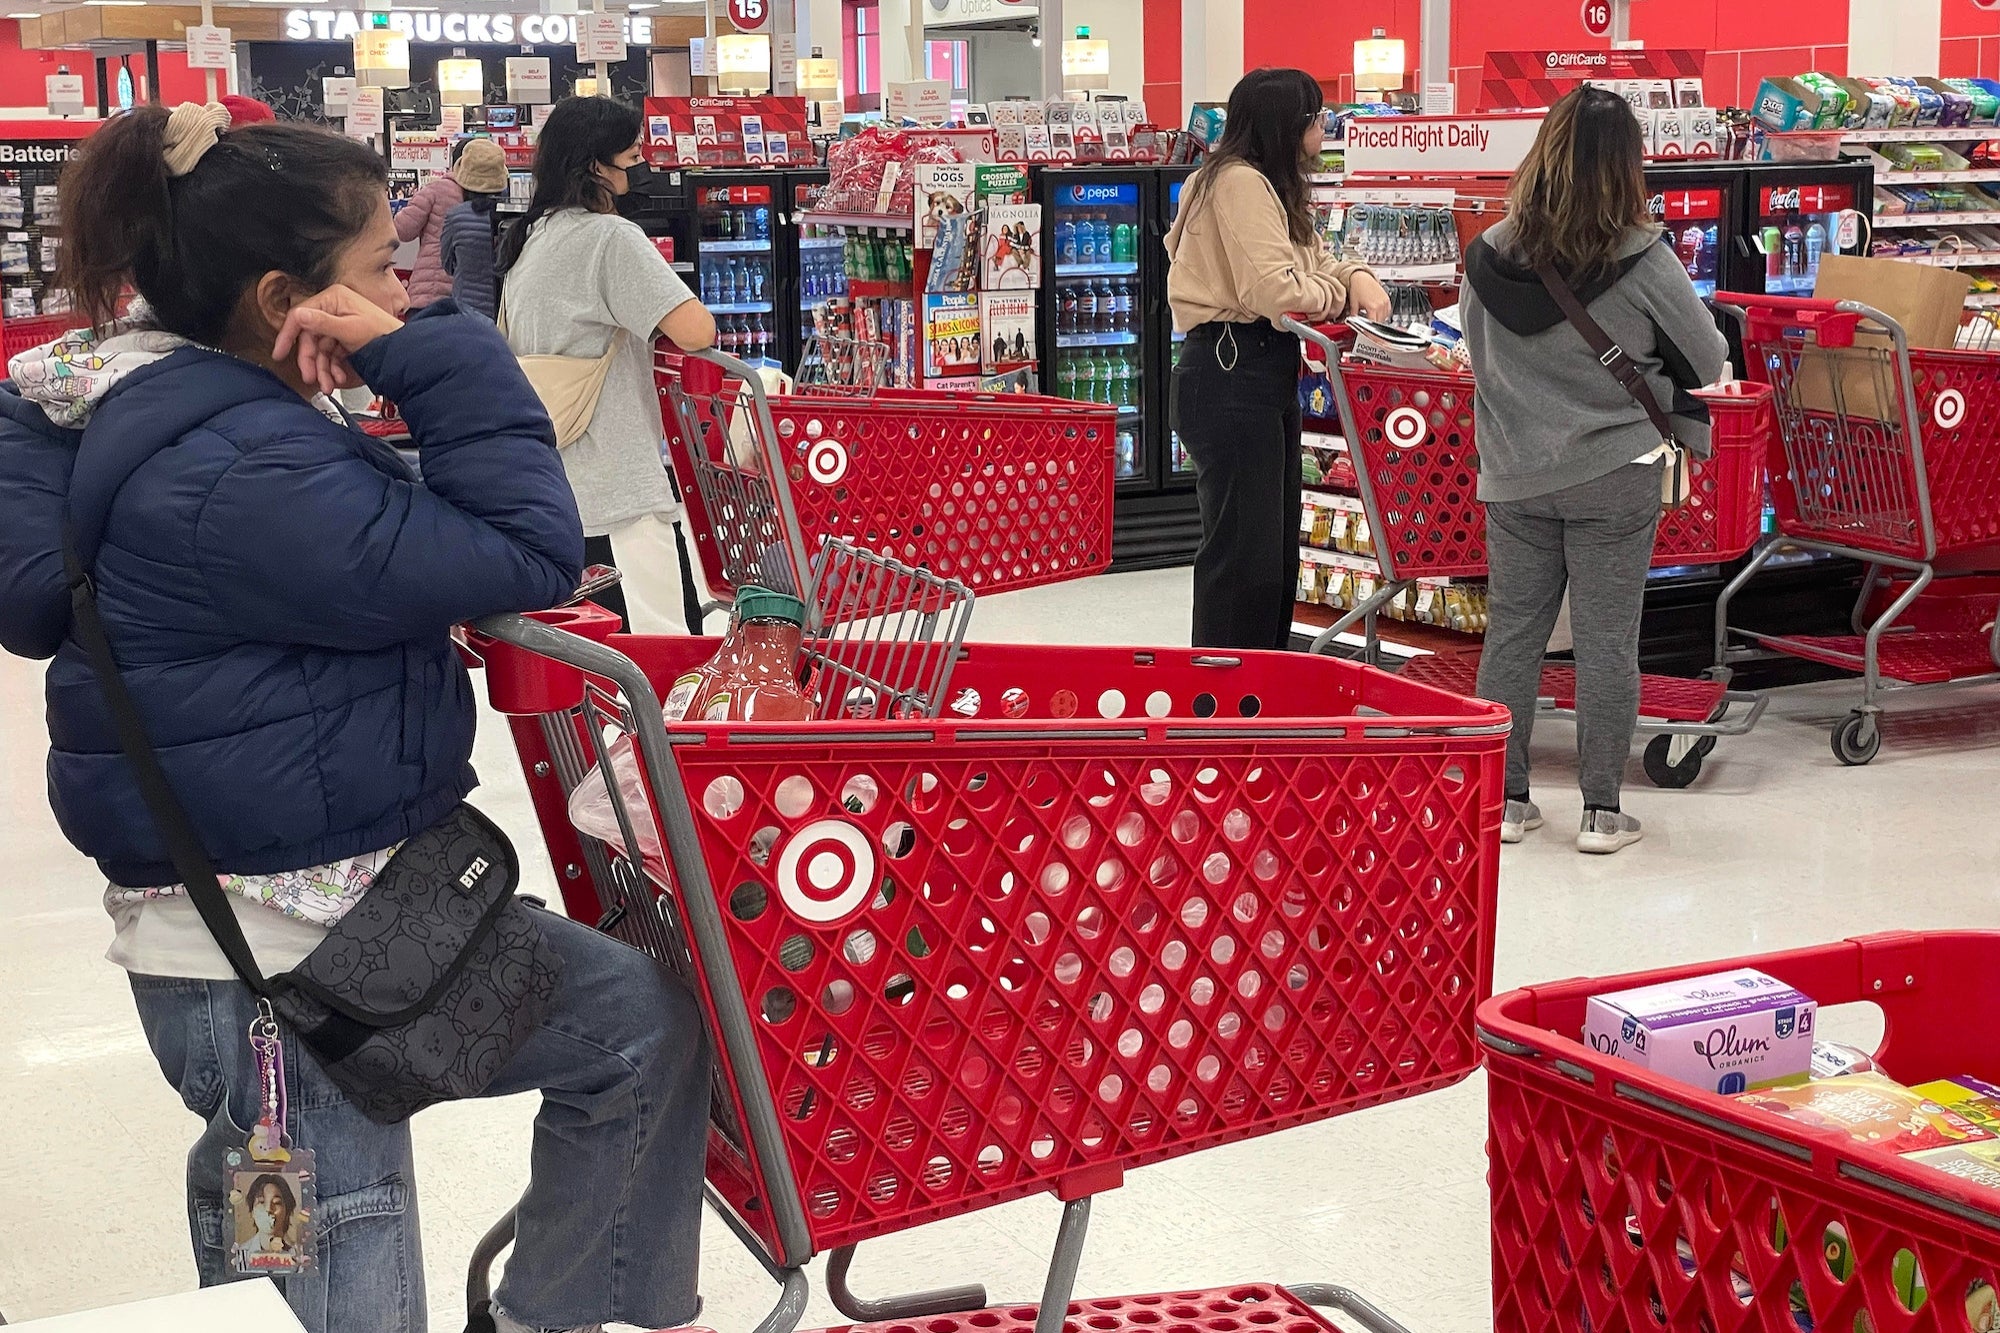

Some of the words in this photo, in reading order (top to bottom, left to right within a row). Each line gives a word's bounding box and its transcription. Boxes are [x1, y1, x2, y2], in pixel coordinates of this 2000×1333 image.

[734, 0, 763, 19] 15
[1589, 7, 1606, 24] 16
[1558, 53, 1607, 66] GiftCards
[698, 99, 734, 107] GiftCards
[1349, 126, 1398, 148] Priced
[1402, 125, 1444, 153] Right
[1449, 124, 1490, 151] Daily
[0, 144, 82, 163] Batterie
[933, 173, 964, 182] DOGS
[981, 172, 1024, 181] CROSSWORD
[988, 180, 1018, 188] PUZZLES
[1087, 186, 1119, 200] pepsi
[990, 210, 1039, 219] MAGNOLIA
[942, 295, 966, 306] People
[990, 304, 1006, 317] ELLIS
[1007, 303, 1028, 316] ISLAND
[929, 321, 952, 334] STARS
[959, 319, 980, 331] ICONS
[1356, 347, 1392, 362] essentials
[1357, 343, 1377, 353] room
[949, 381, 976, 389] Parent's
[459, 857, 489, 889] BT21
[1782, 1024, 1788, 1032] 2
[1800, 1016, 1809, 1030] 4
[1703, 1024, 1769, 1071] Plum
[1719, 1056, 1765, 1069] ORGANICS
